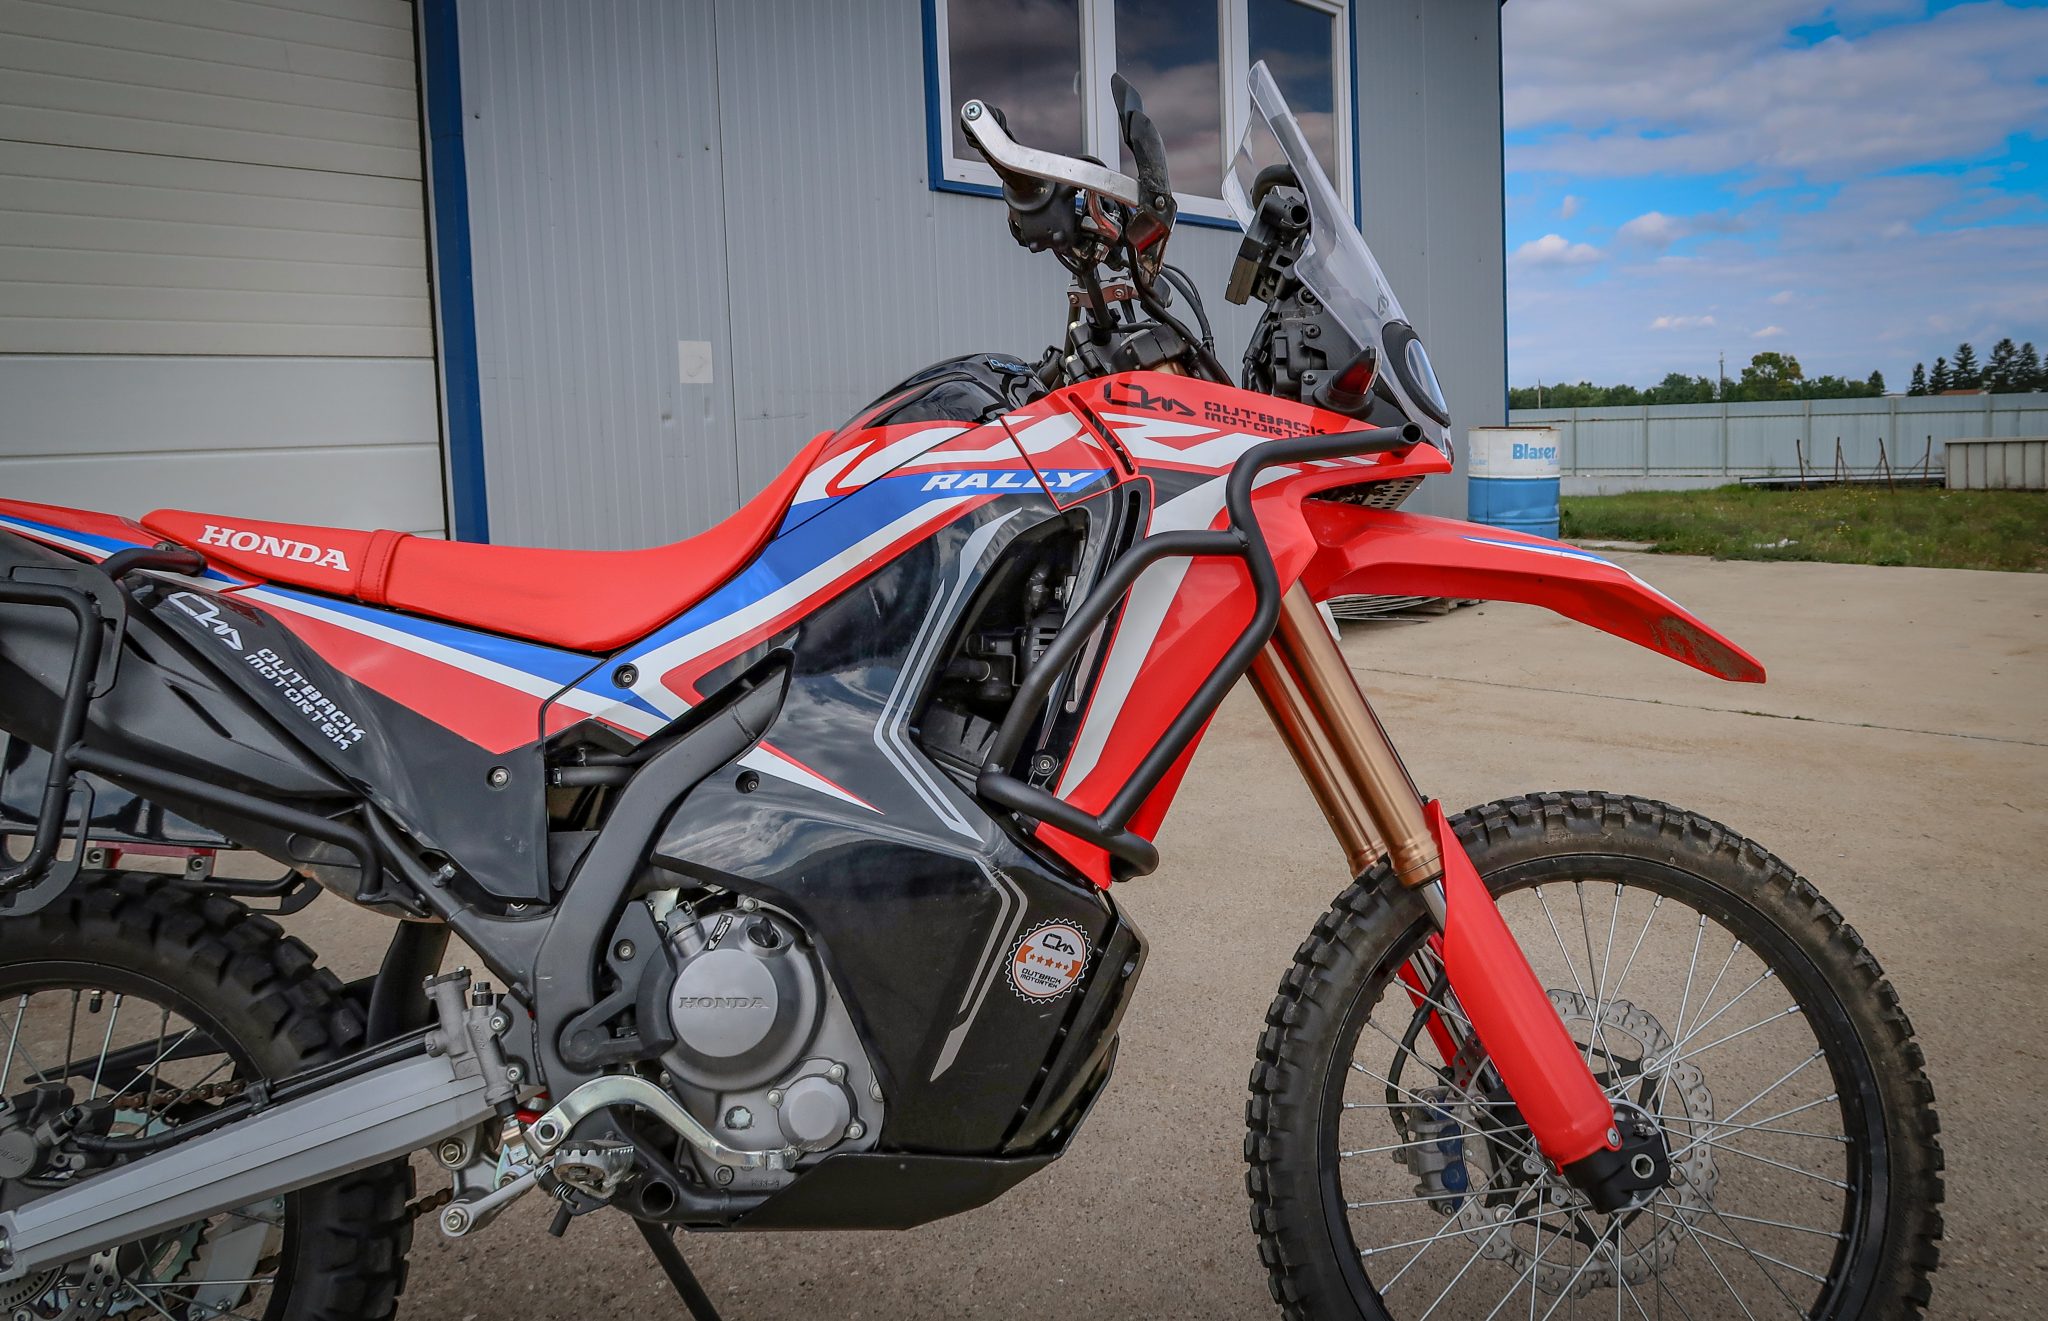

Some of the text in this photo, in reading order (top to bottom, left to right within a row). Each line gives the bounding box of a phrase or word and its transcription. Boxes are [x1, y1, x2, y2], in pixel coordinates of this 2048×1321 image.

[1204, 401, 1327, 436] OUTBACK
[1204, 412, 1310, 438] MOTORT
[920, 472, 1094, 492] RALLY
[198, 524, 350, 572] HONDA
[244, 654, 353, 750] MOTORTEK
[256, 648, 366, 741] OUTBACK
[1020, 974, 1058, 989] MOTORTEK
[1021, 968, 1062, 985] OUTBACK
[679, 997, 769, 1009] HONDA
